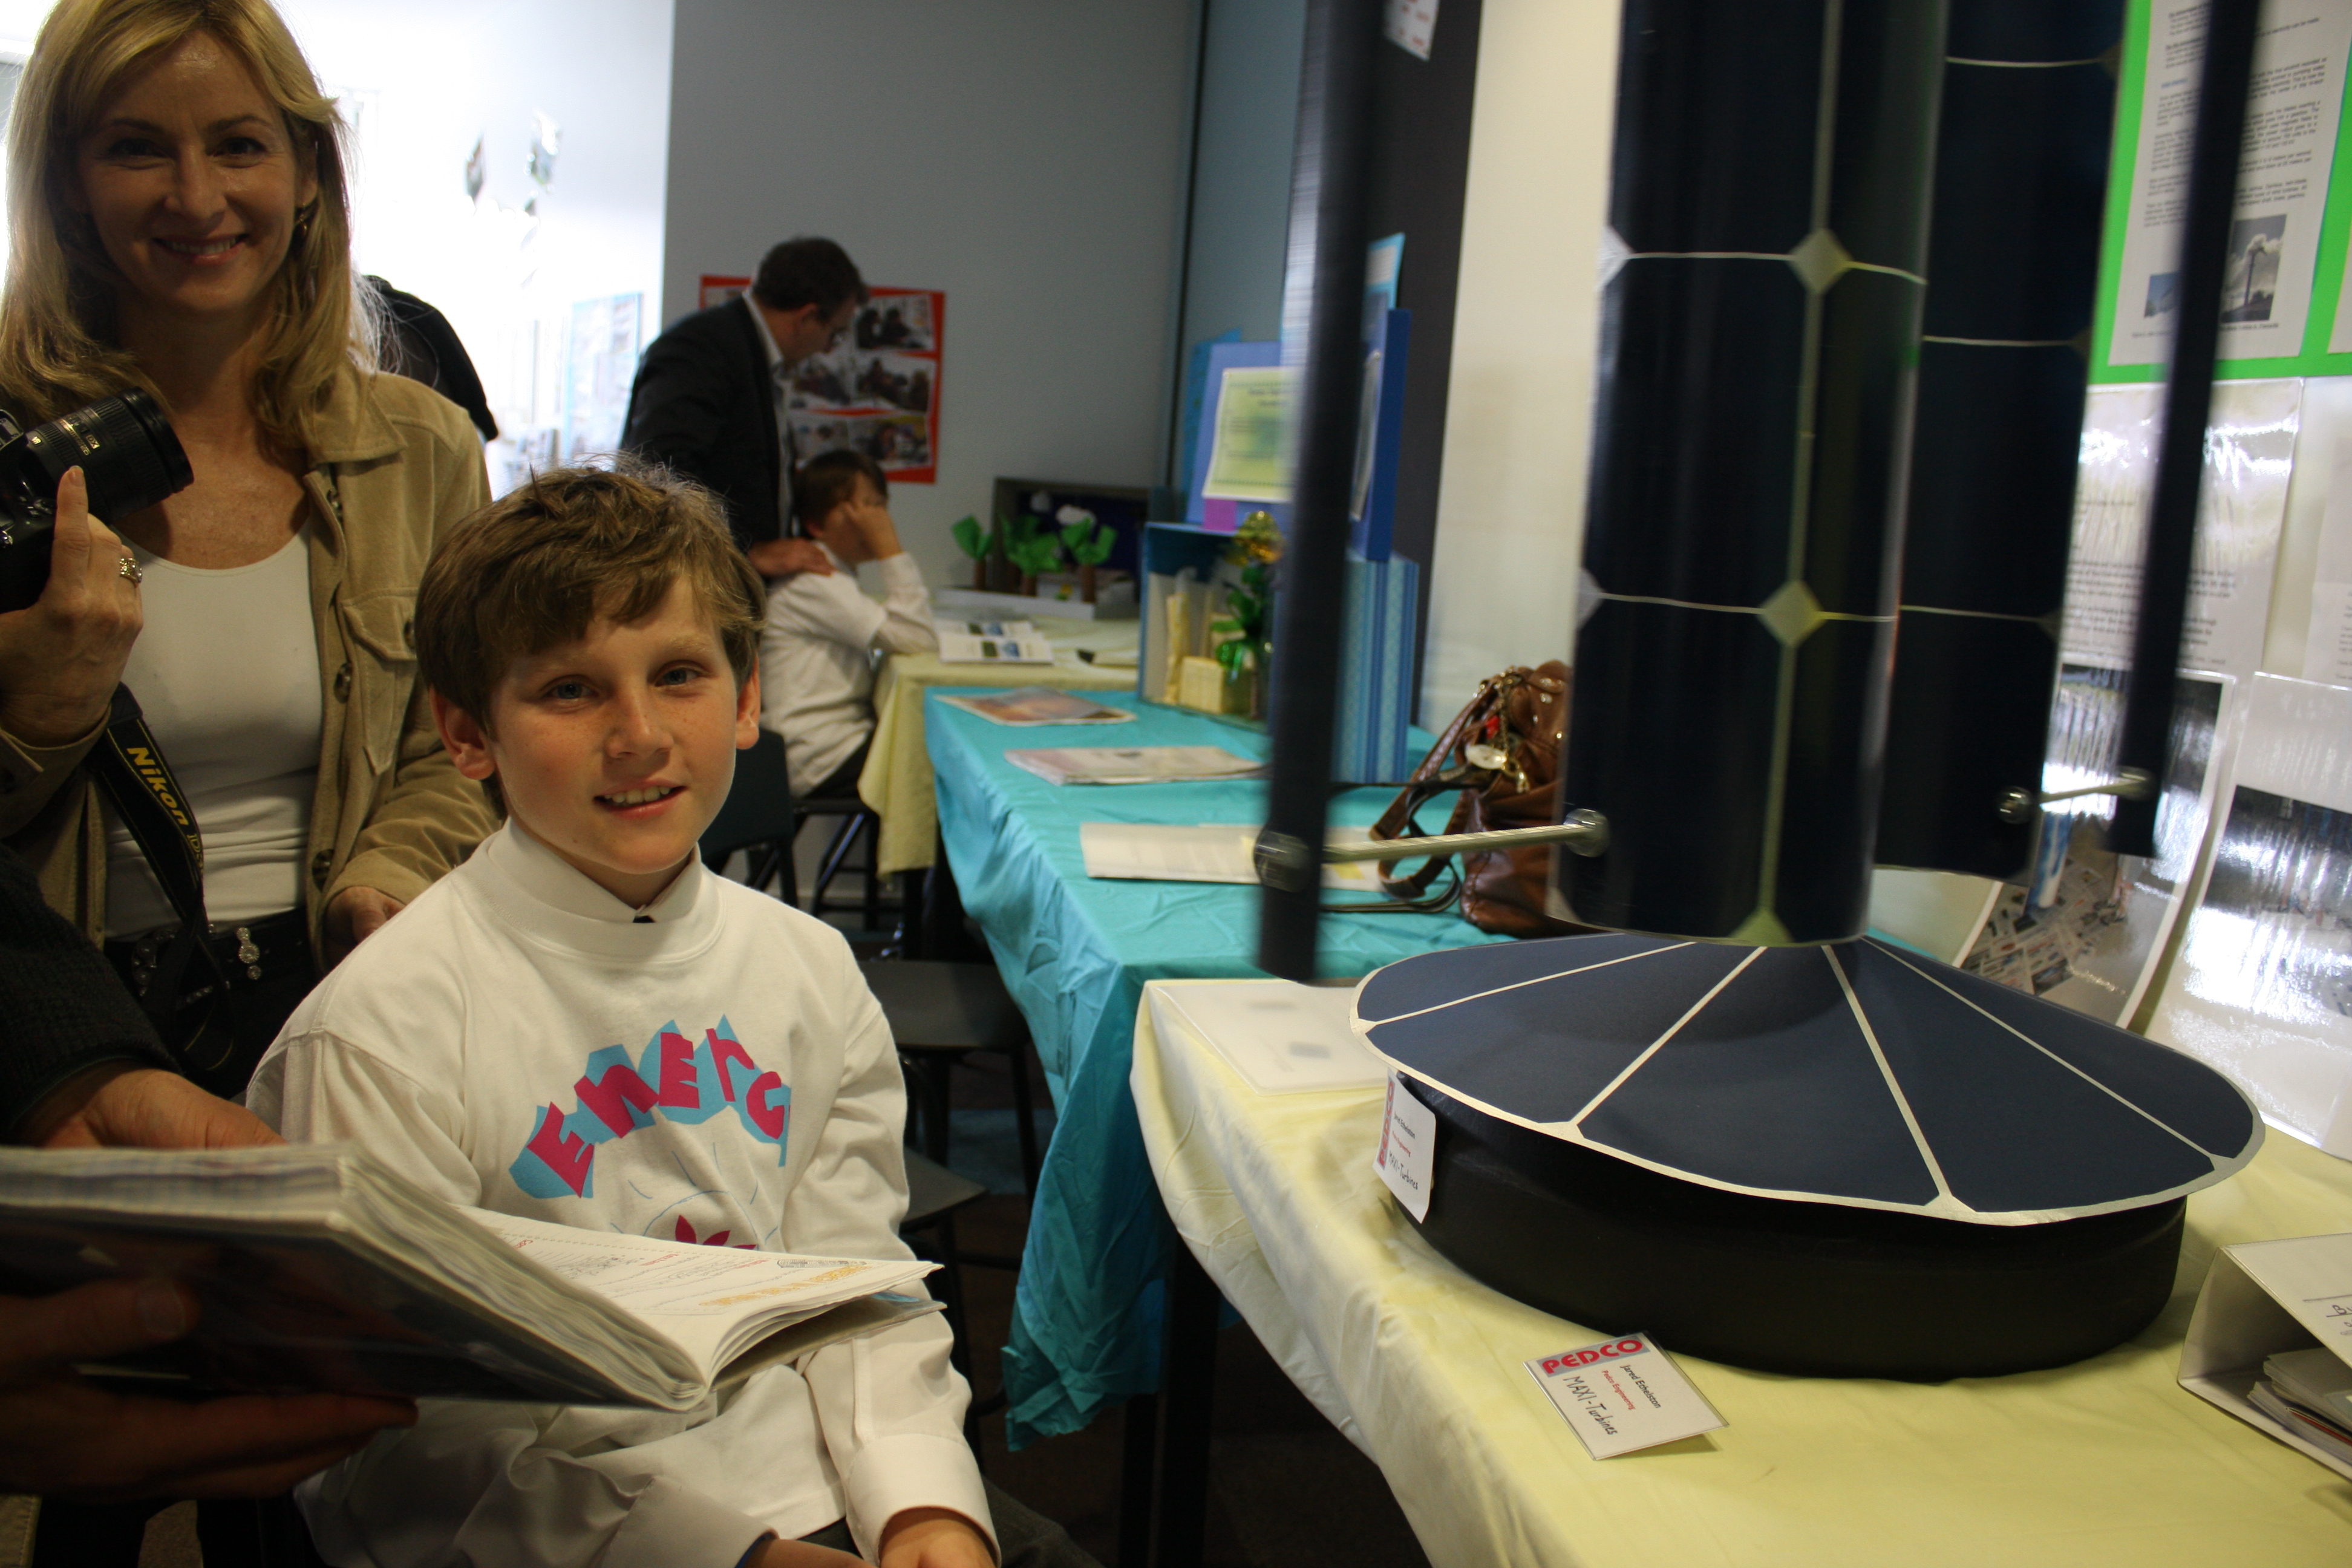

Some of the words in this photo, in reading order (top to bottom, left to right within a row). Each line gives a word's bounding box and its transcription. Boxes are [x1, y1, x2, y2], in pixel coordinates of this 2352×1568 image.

[126, 747, 189, 826] Nikon
[1542, 1339, 1643, 1374] PEDCO
[1601, 1370, 1615, 1384] Pedco
[1612, 1383, 1636, 1410] Engineering
[1619, 1365, 1641, 1380] Jared
[1635, 1380, 1661, 1408] Ethelston
